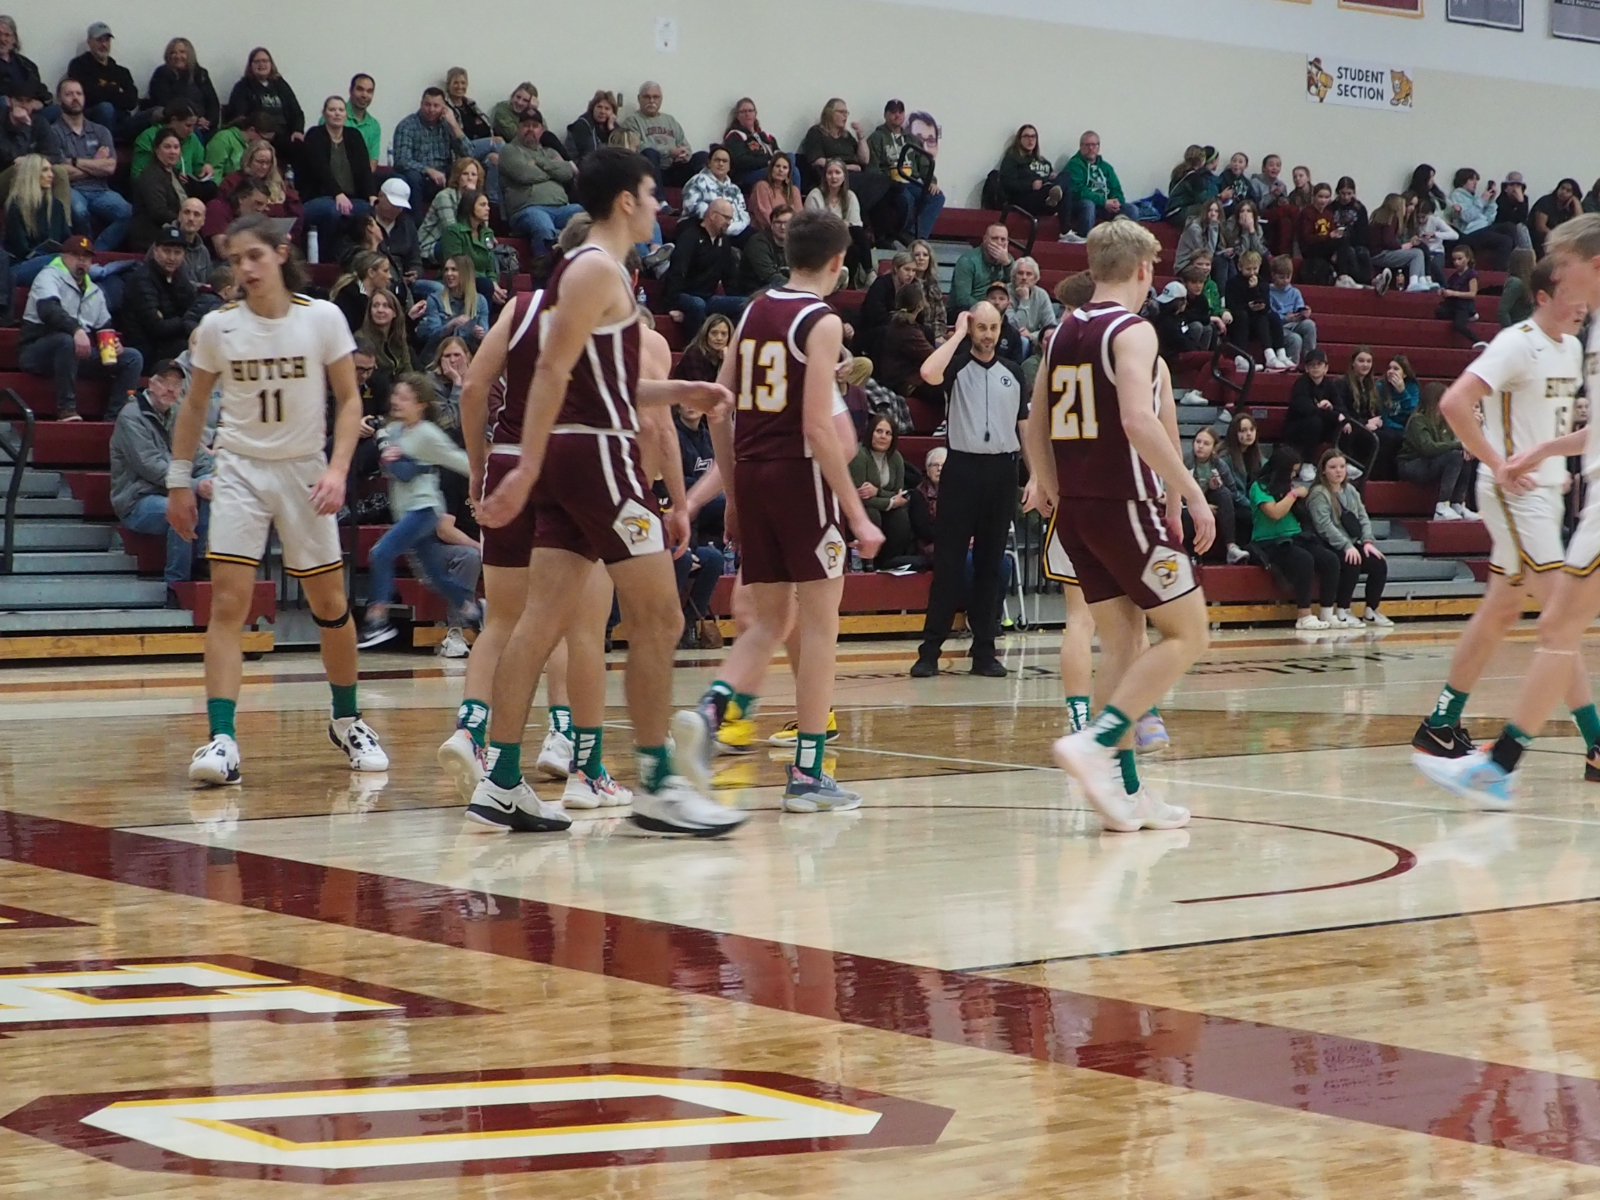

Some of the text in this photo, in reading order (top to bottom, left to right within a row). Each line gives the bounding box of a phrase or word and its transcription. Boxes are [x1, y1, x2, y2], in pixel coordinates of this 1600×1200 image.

[1336, 83, 1384, 101] SECTION
[1337, 66, 1385, 84] STUDENT
[737, 338, 788, 413] 13
[257, 388, 284, 423] 11
[1050, 363, 1099, 440] 21
